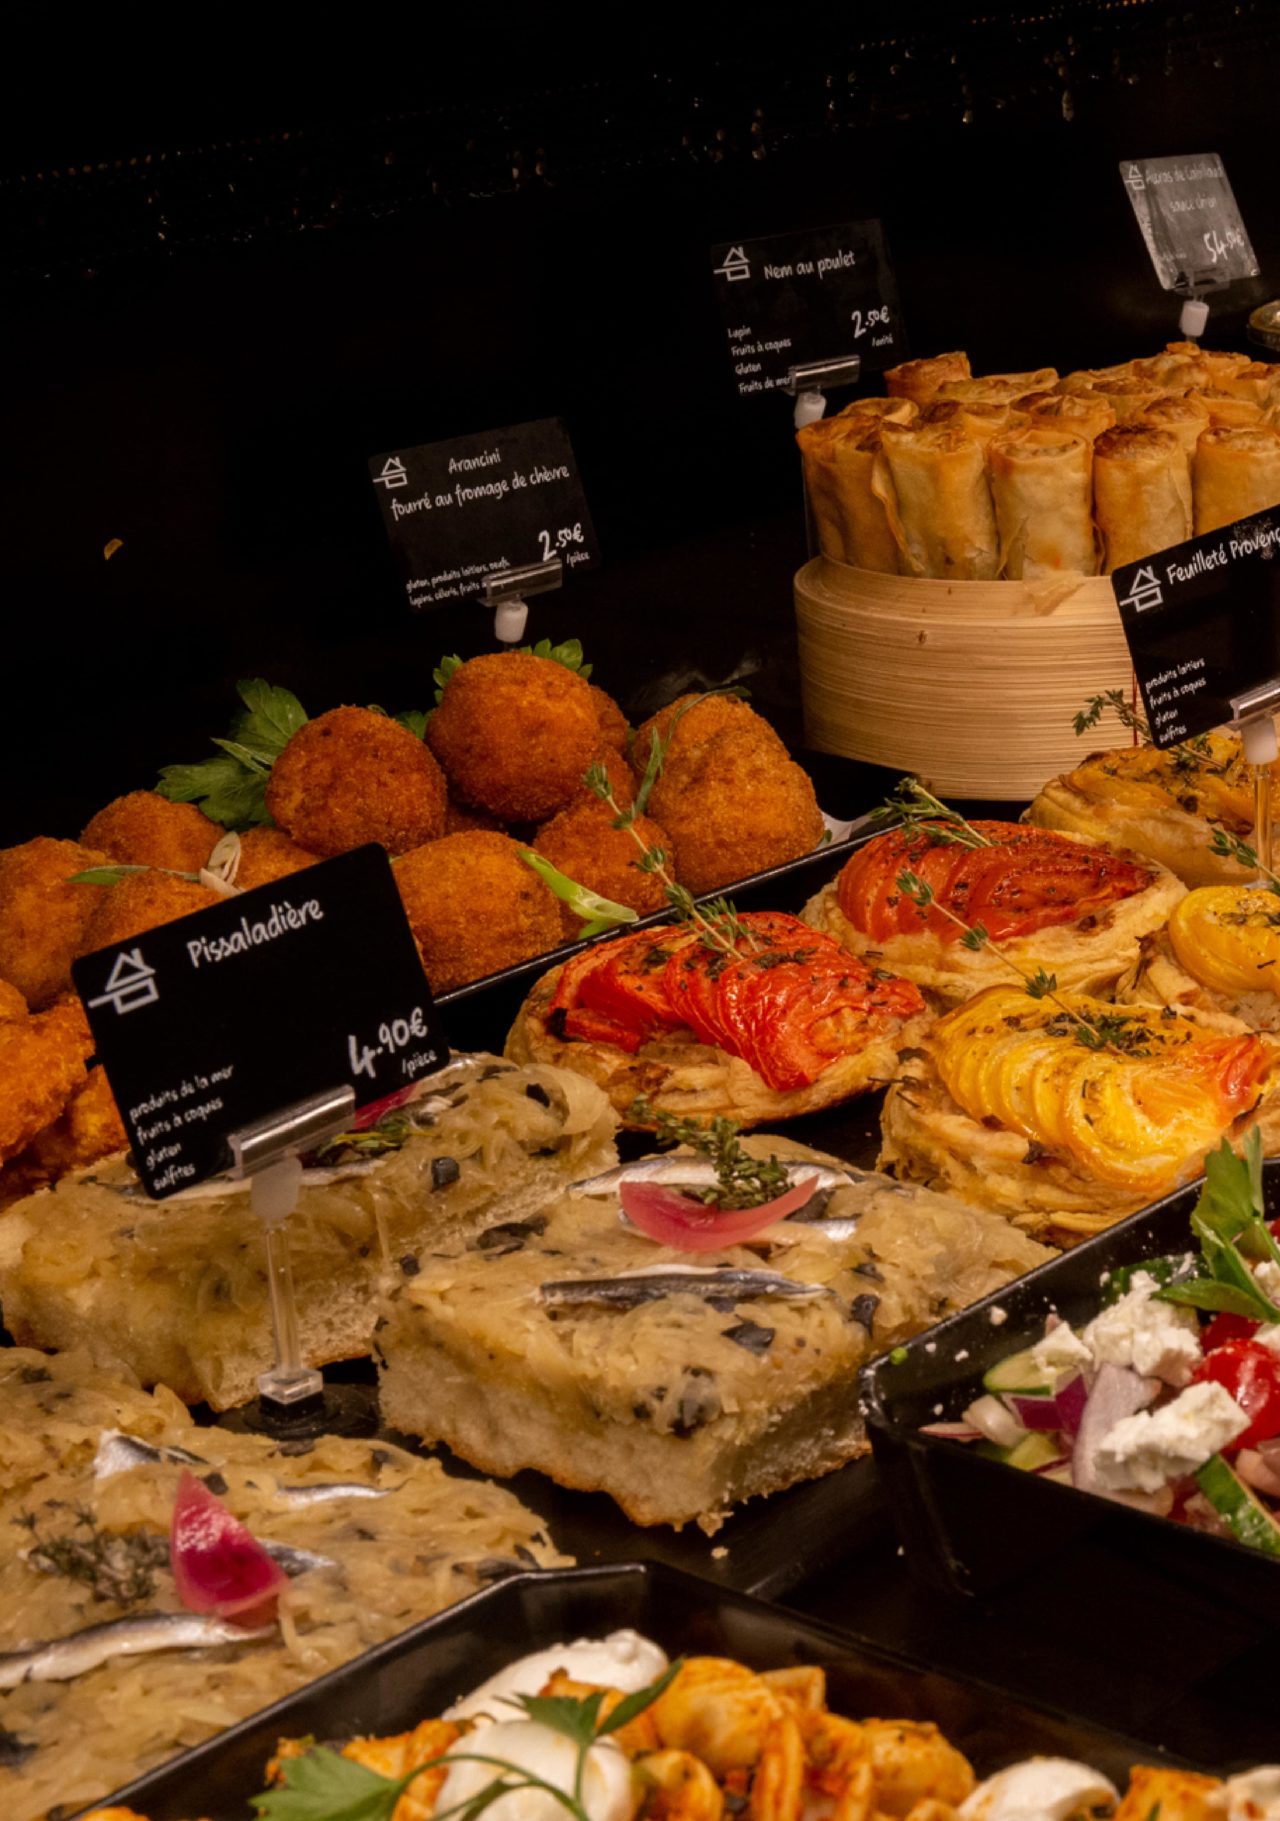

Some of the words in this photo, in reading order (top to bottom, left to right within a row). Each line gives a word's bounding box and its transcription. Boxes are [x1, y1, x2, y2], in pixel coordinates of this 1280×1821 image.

[764, 264, 793, 280] Nem
[796, 261, 814, 275] au
[817, 249, 855, 279] poulet
[851, 306, 890, 339] 2.50€
[731, 344, 756, 357] Fruits
[757, 341, 764, 352] à
[764, 338, 792, 354] coques
[735, 362, 762, 375] Gluten
[738, 380, 763, 394] Fruits
[764, 376, 774, 388] de
[448, 448, 501, 473] Arancini
[390, 492, 432, 521] fourré
[435, 493, 453, 507] au
[455, 478, 509, 507] fromage
[512, 471, 527, 490] de
[529, 464, 570, 485] chèvre
[538, 522, 584, 562] 2.50€
[1167, 543, 1228, 585] Feuilleté
[1145, 670, 1177, 694] produits
[1177, 657, 1205, 675] laitiers
[1149, 692, 1172, 710] fruits
[1180, 677, 1206, 695] coques
[187, 899, 324, 968] Pissaladière
[348, 1006, 427, 1078] 4.90€
[401, 1049, 437, 1078] /pièce
[129, 1082, 180, 1124] produits
[180, 1074, 195, 1095] de
[194, 1072, 210, 1091] la
[211, 1064, 234, 1085] mer
[136, 1116, 171, 1146] fruits
[172, 1110, 183, 1128] à
[184, 1097, 223, 1127] coques
[145, 1141, 182, 1171] gluten
[153, 1162, 196, 1191] sulfites
